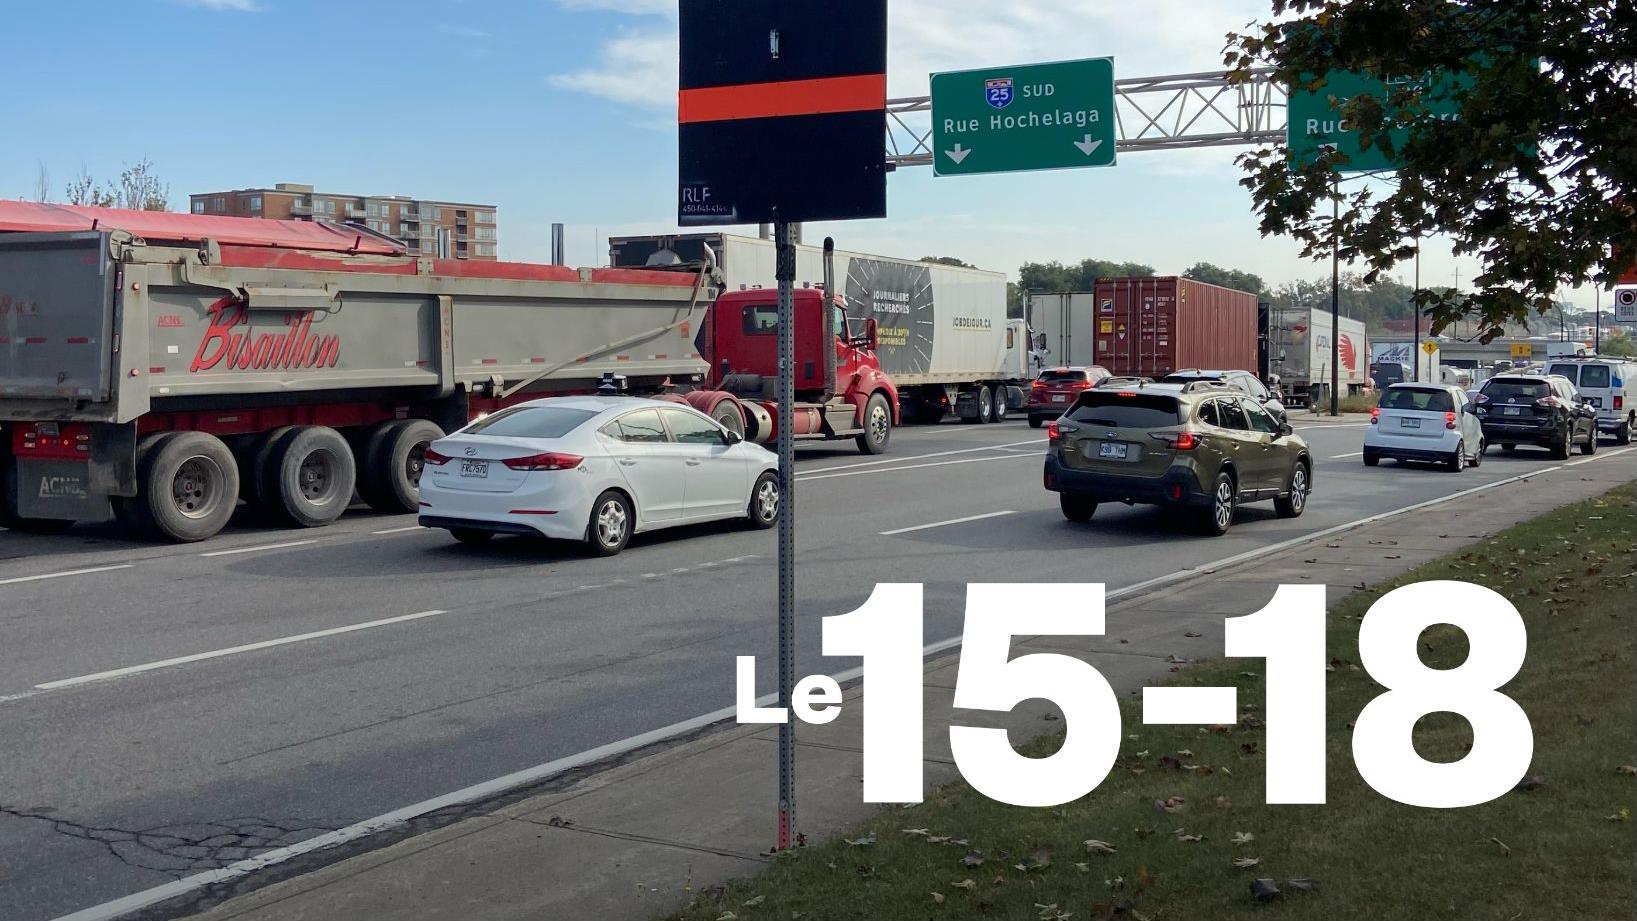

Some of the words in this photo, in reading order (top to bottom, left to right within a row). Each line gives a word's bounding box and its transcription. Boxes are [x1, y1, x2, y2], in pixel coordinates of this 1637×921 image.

[990, 88, 1009, 101] 25
[1023, 83, 1055, 98] SUD
[944, 118, 980, 134] Rue
[990, 109, 1099, 128] Hochelaga
[682, 187, 711, 203] RLF
[189, 294, 341, 373] Bisaillon
